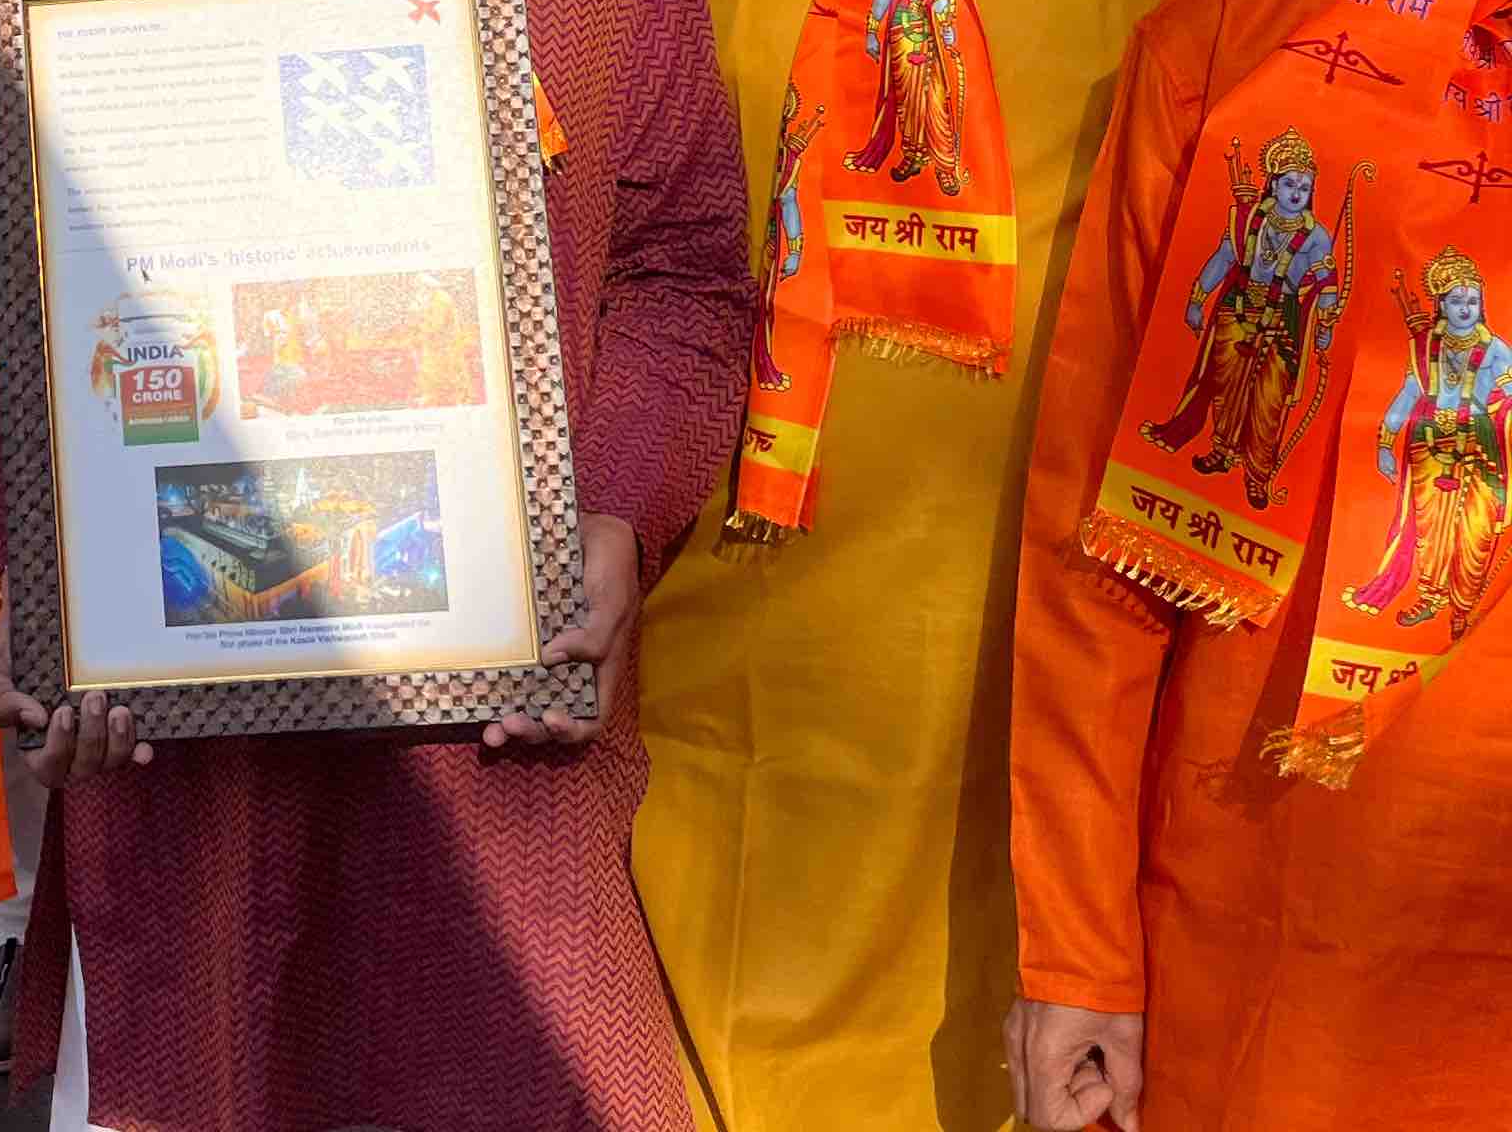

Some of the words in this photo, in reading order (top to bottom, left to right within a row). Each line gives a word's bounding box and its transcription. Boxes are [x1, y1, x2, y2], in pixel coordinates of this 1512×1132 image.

[843, 214, 889, 243] जय
[894, 212, 926, 247] श्री
[932, 224, 978, 253] राम
[127, 256, 155, 272] PM
[160, 252, 218, 269] Modi's
[127, 345, 184, 362] INDIA
[133, 369, 183, 391] 150
[132, 390, 183, 404] CRORE
[1131, 485, 1183, 529] जय
[1188, 511, 1224, 549] श्री
[1231, 532, 1283, 576] राम
[1331, 659, 1381, 691] जय
